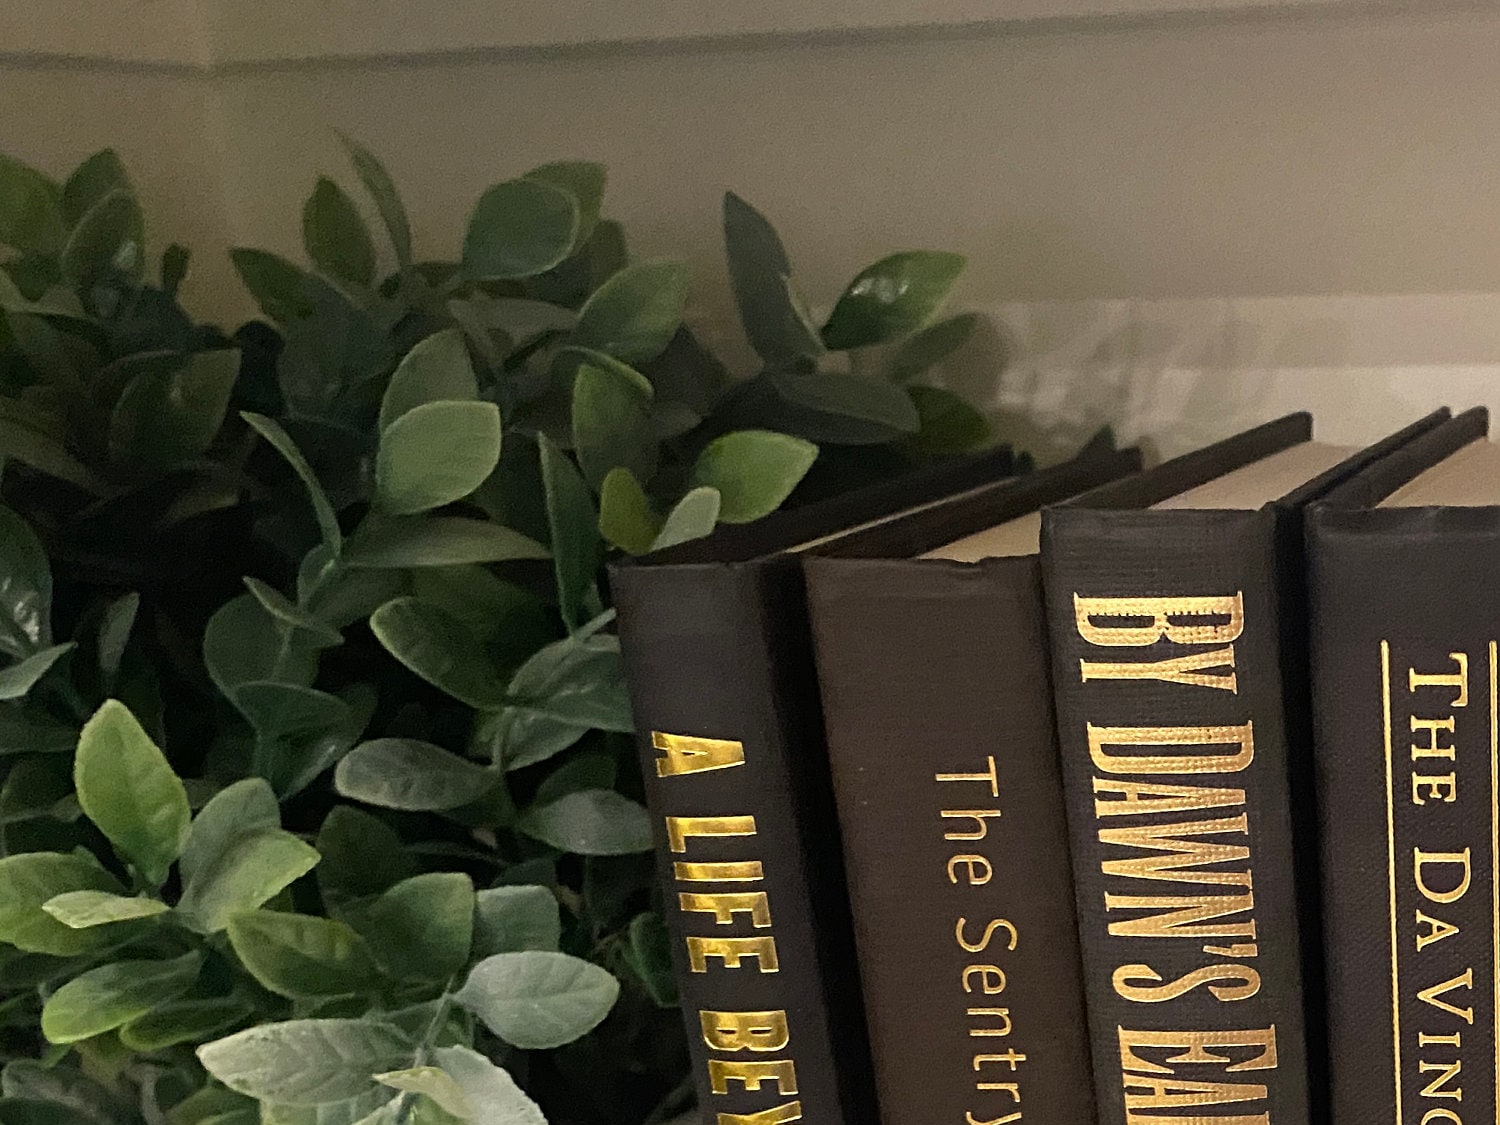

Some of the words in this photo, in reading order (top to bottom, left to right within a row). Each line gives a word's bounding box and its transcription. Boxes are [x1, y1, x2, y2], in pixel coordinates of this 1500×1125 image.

[1074, 591, 1244, 694] BY
[652, 731, 745, 777] A
[1409, 653, 1468, 805] THE
[936, 756, 1001, 885] The
[1087, 720, 1260, 1002] DAWN'S
[666, 816, 779, 973] LIFE
[1414, 847, 1471, 952] DA
